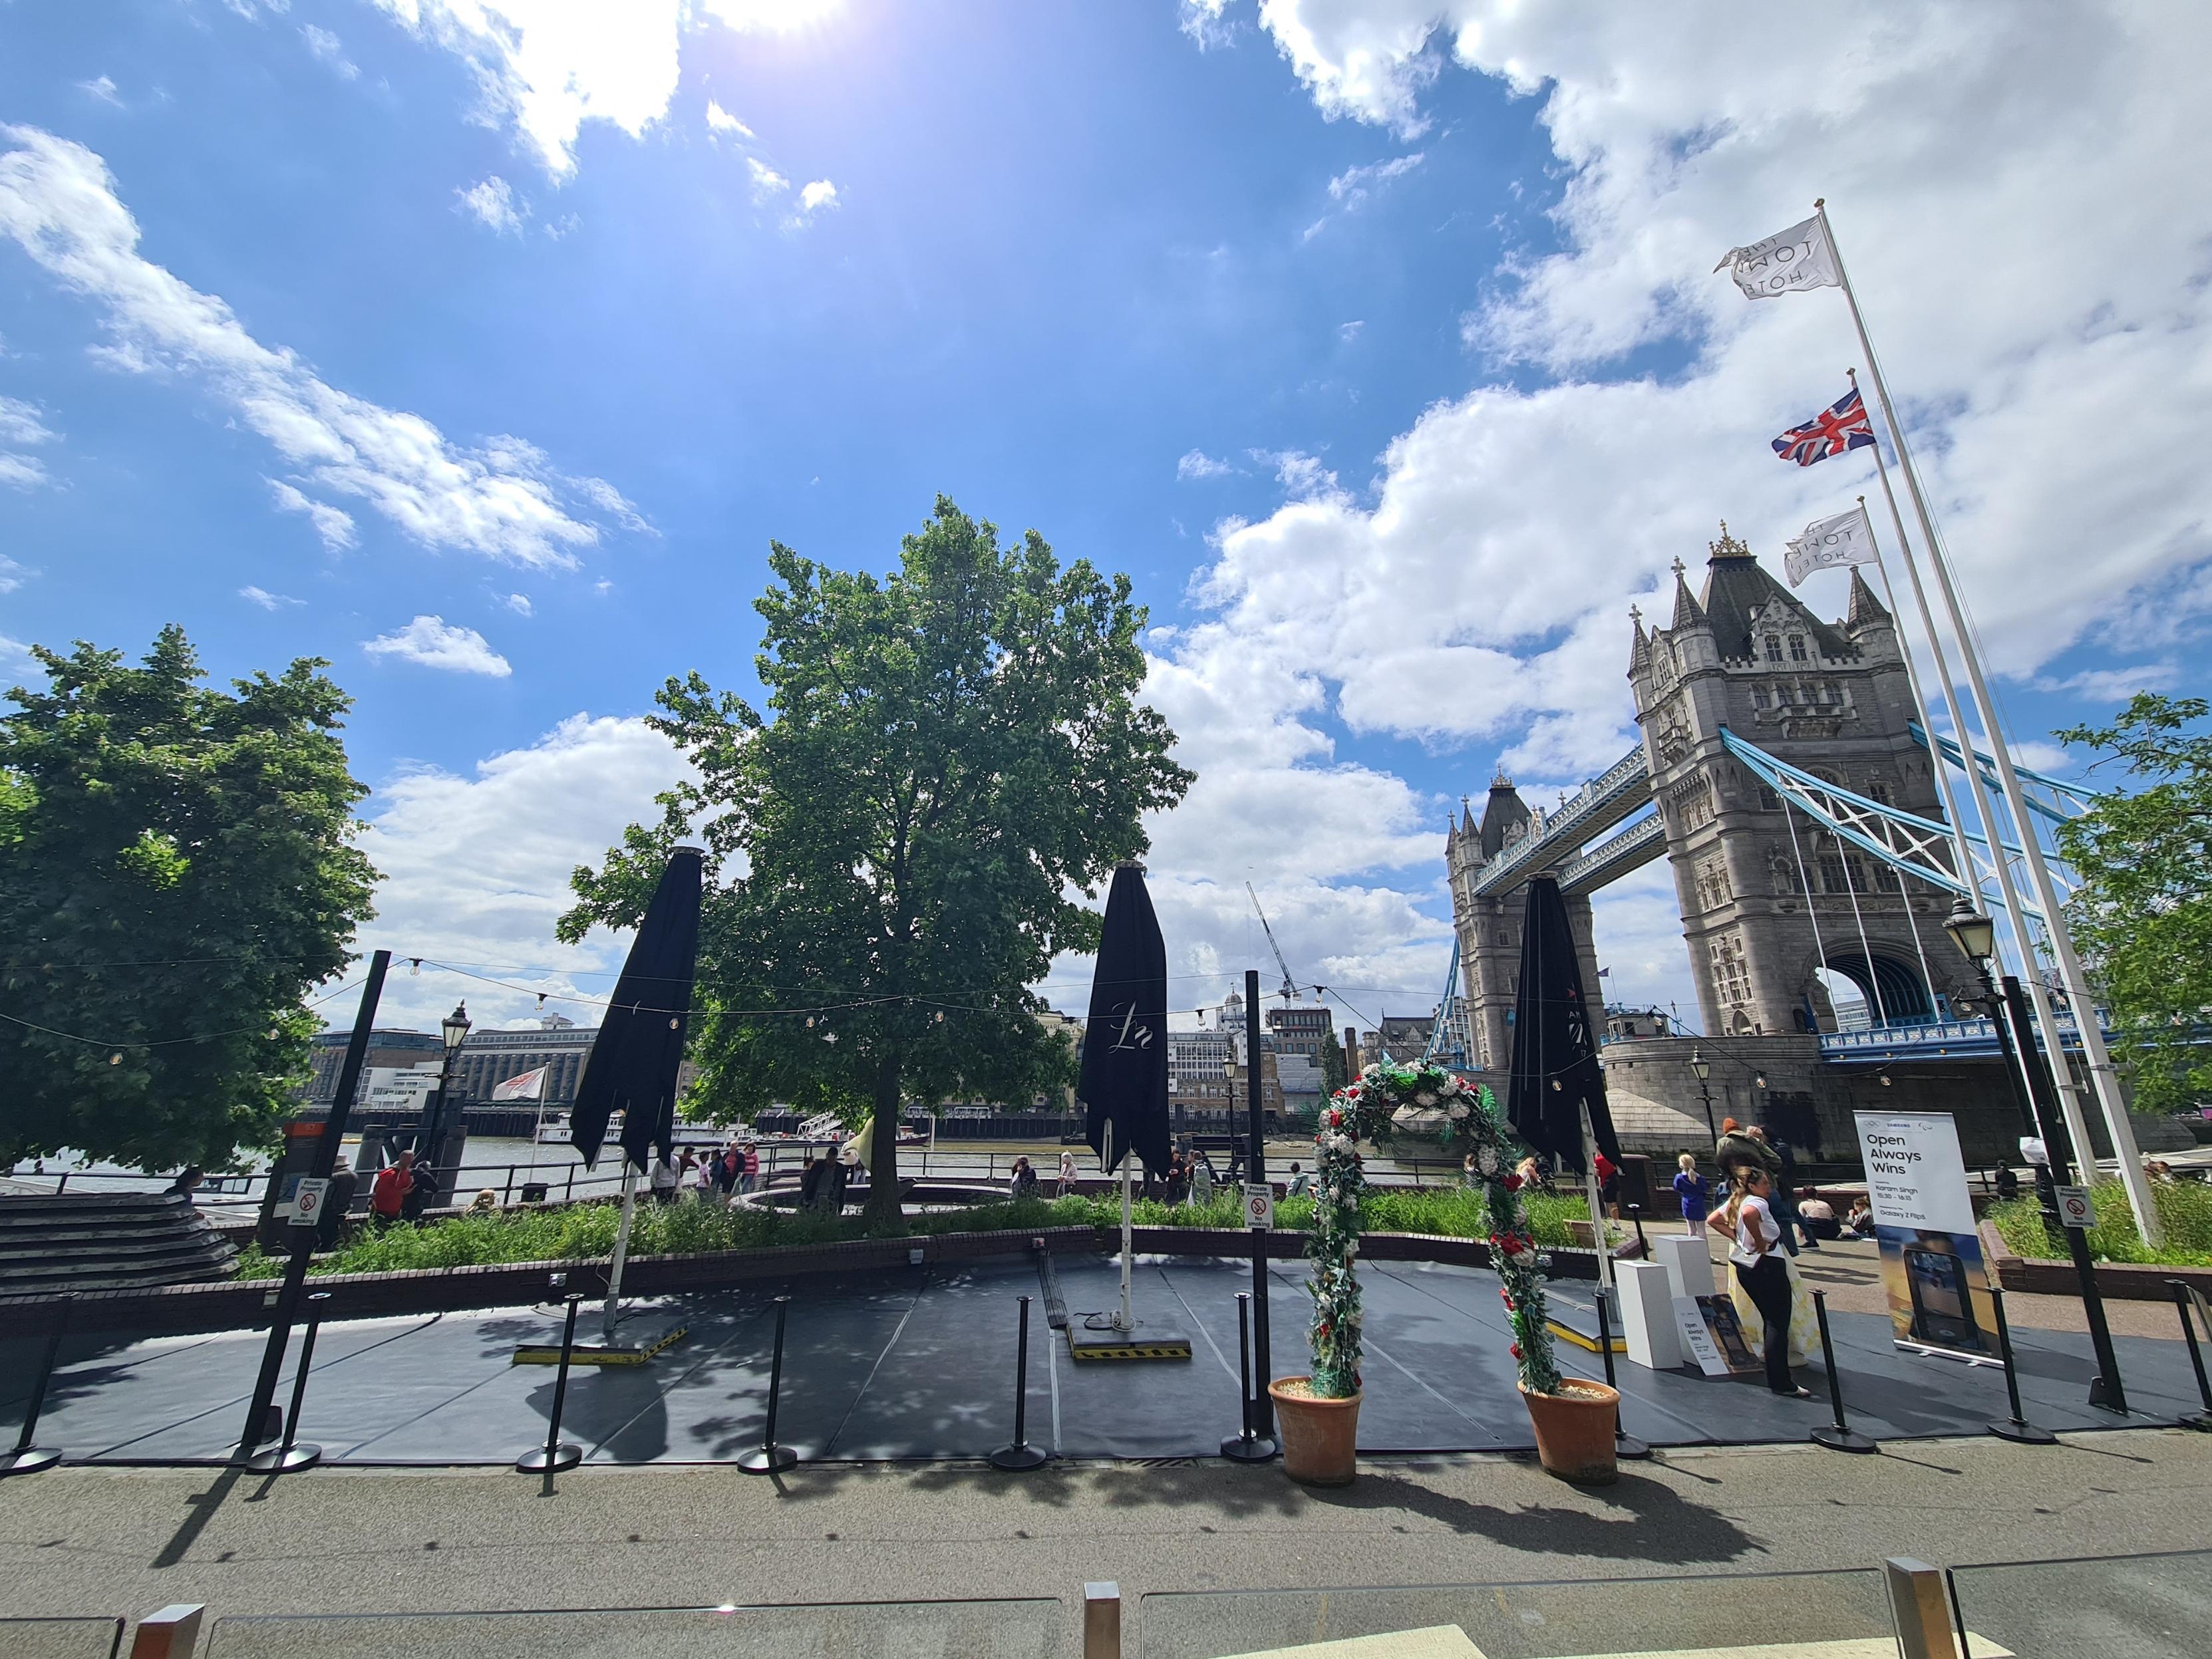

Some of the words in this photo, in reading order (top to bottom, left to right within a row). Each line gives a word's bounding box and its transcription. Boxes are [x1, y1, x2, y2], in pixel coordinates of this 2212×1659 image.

[1867, 1133, 1906, 1147] Open
[1871, 1148, 1922, 1163] Always
[1871, 1162, 1906, 1175] Wins
[1880, 1210, 1904, 1219] Galaxy
